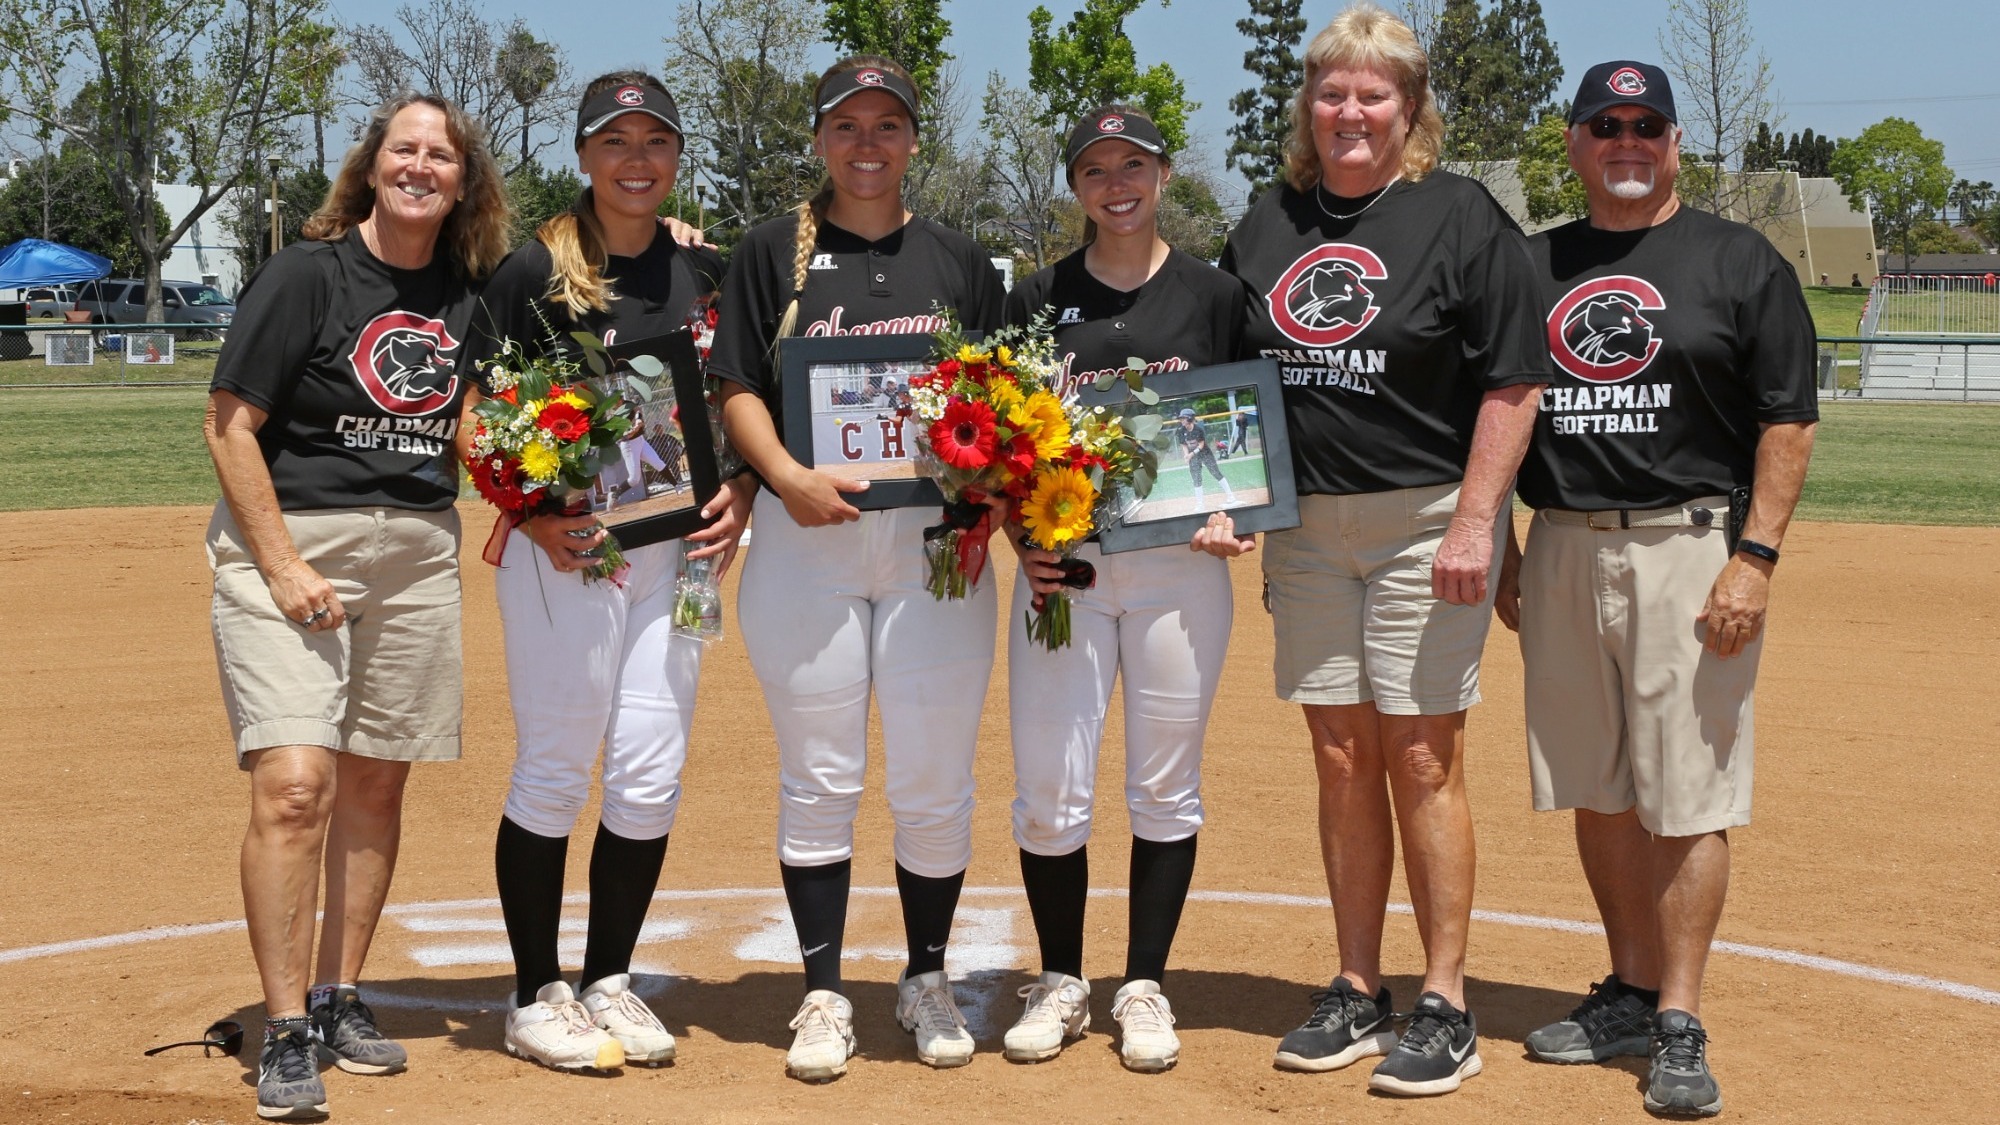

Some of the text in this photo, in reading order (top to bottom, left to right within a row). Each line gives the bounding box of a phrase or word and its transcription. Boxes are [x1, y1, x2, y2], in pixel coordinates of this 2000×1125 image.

[813, 254, 832, 266] R
[1799, 249, 1806, 259] 2
[1865, 252, 1872, 261] 3
[1061, 307, 1080, 320] R
[1282, 367, 1375, 395] SOFTBALL
[1540, 384, 1671, 412] CHAPMAN
[1553, 413, 1659, 434] SOFTBALL
